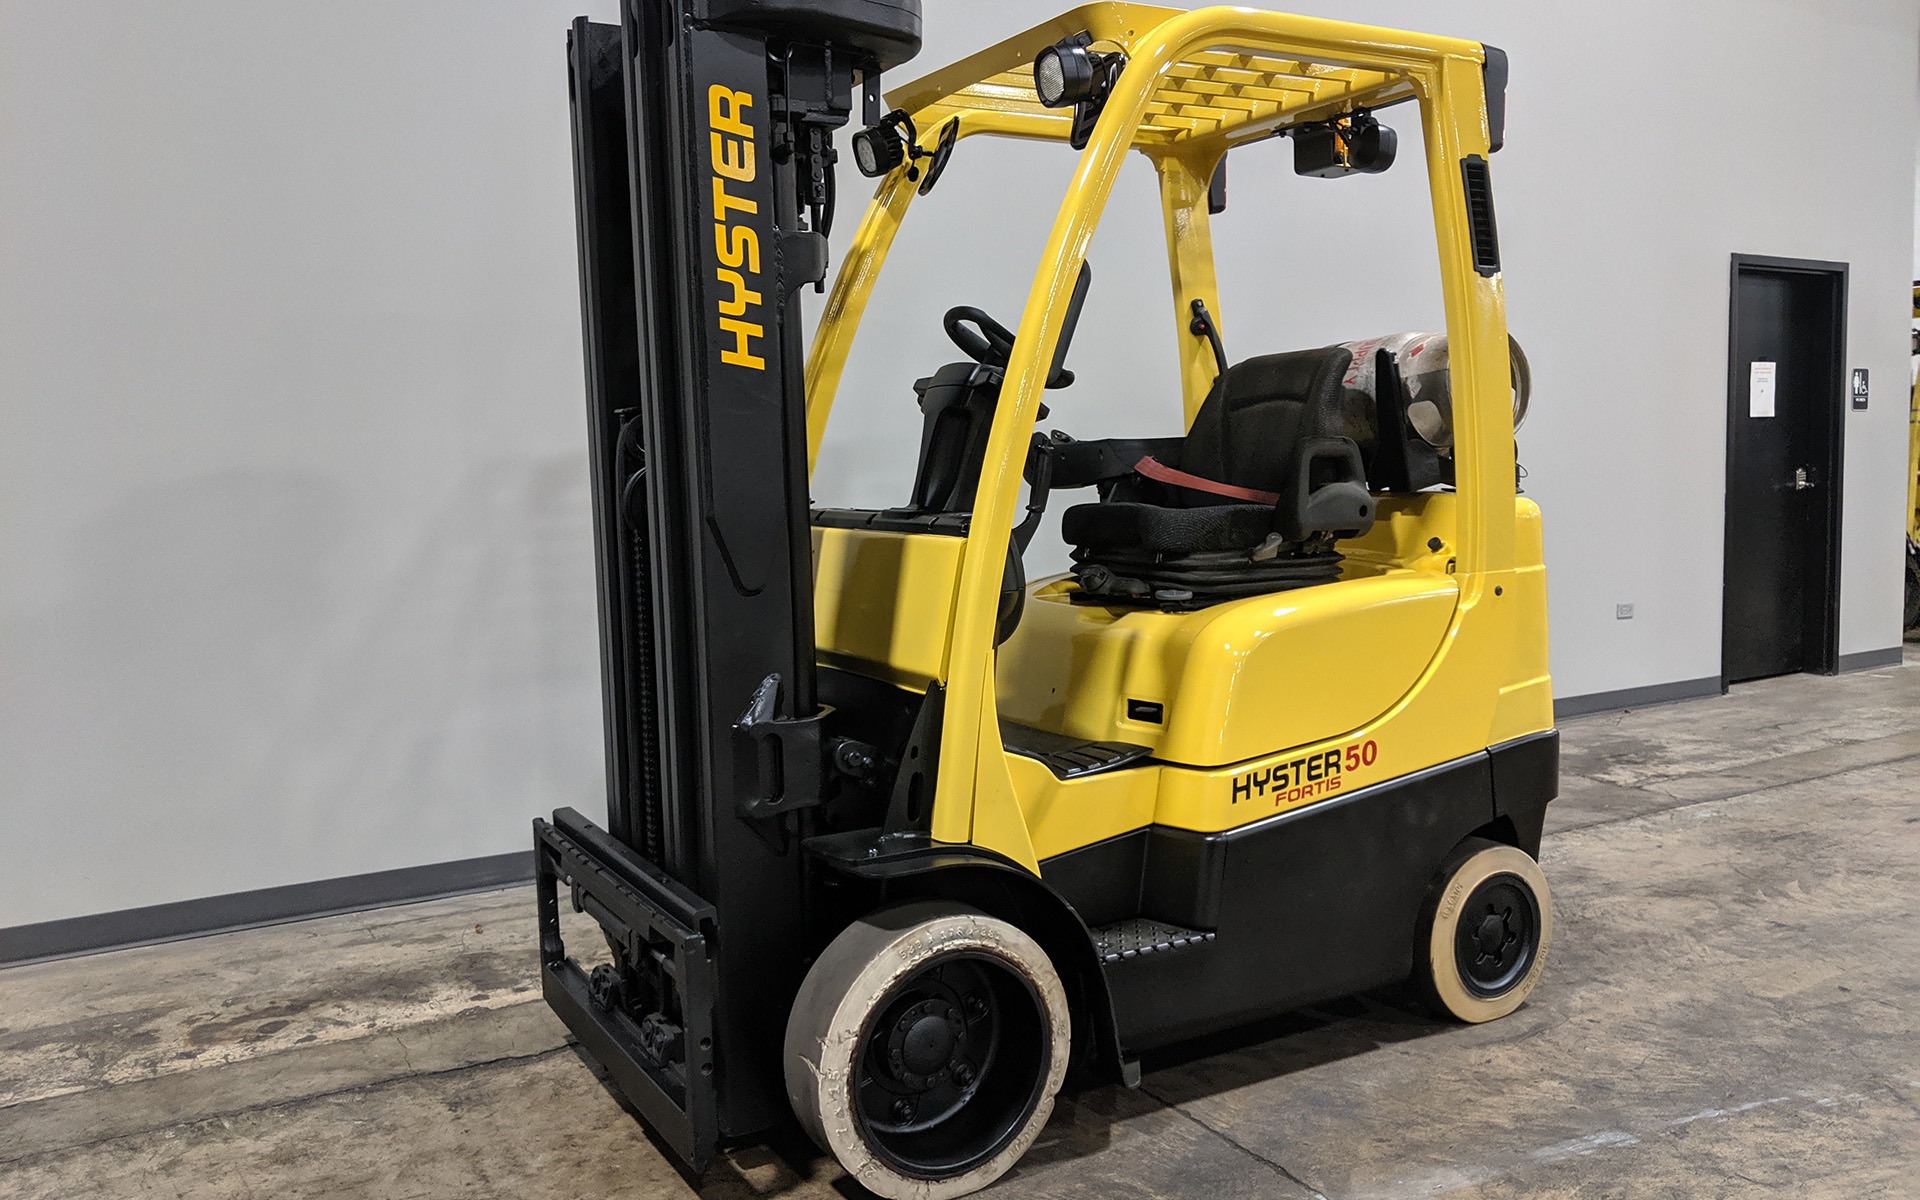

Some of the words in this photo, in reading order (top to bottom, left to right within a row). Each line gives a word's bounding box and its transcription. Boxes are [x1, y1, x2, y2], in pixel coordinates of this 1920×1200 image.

[708, 84, 765, 370] HYSTER
[1232, 749, 1341, 804] HYSTER
[1345, 740, 1377, 772] 50
[1275, 776, 1341, 807] FORTIS
